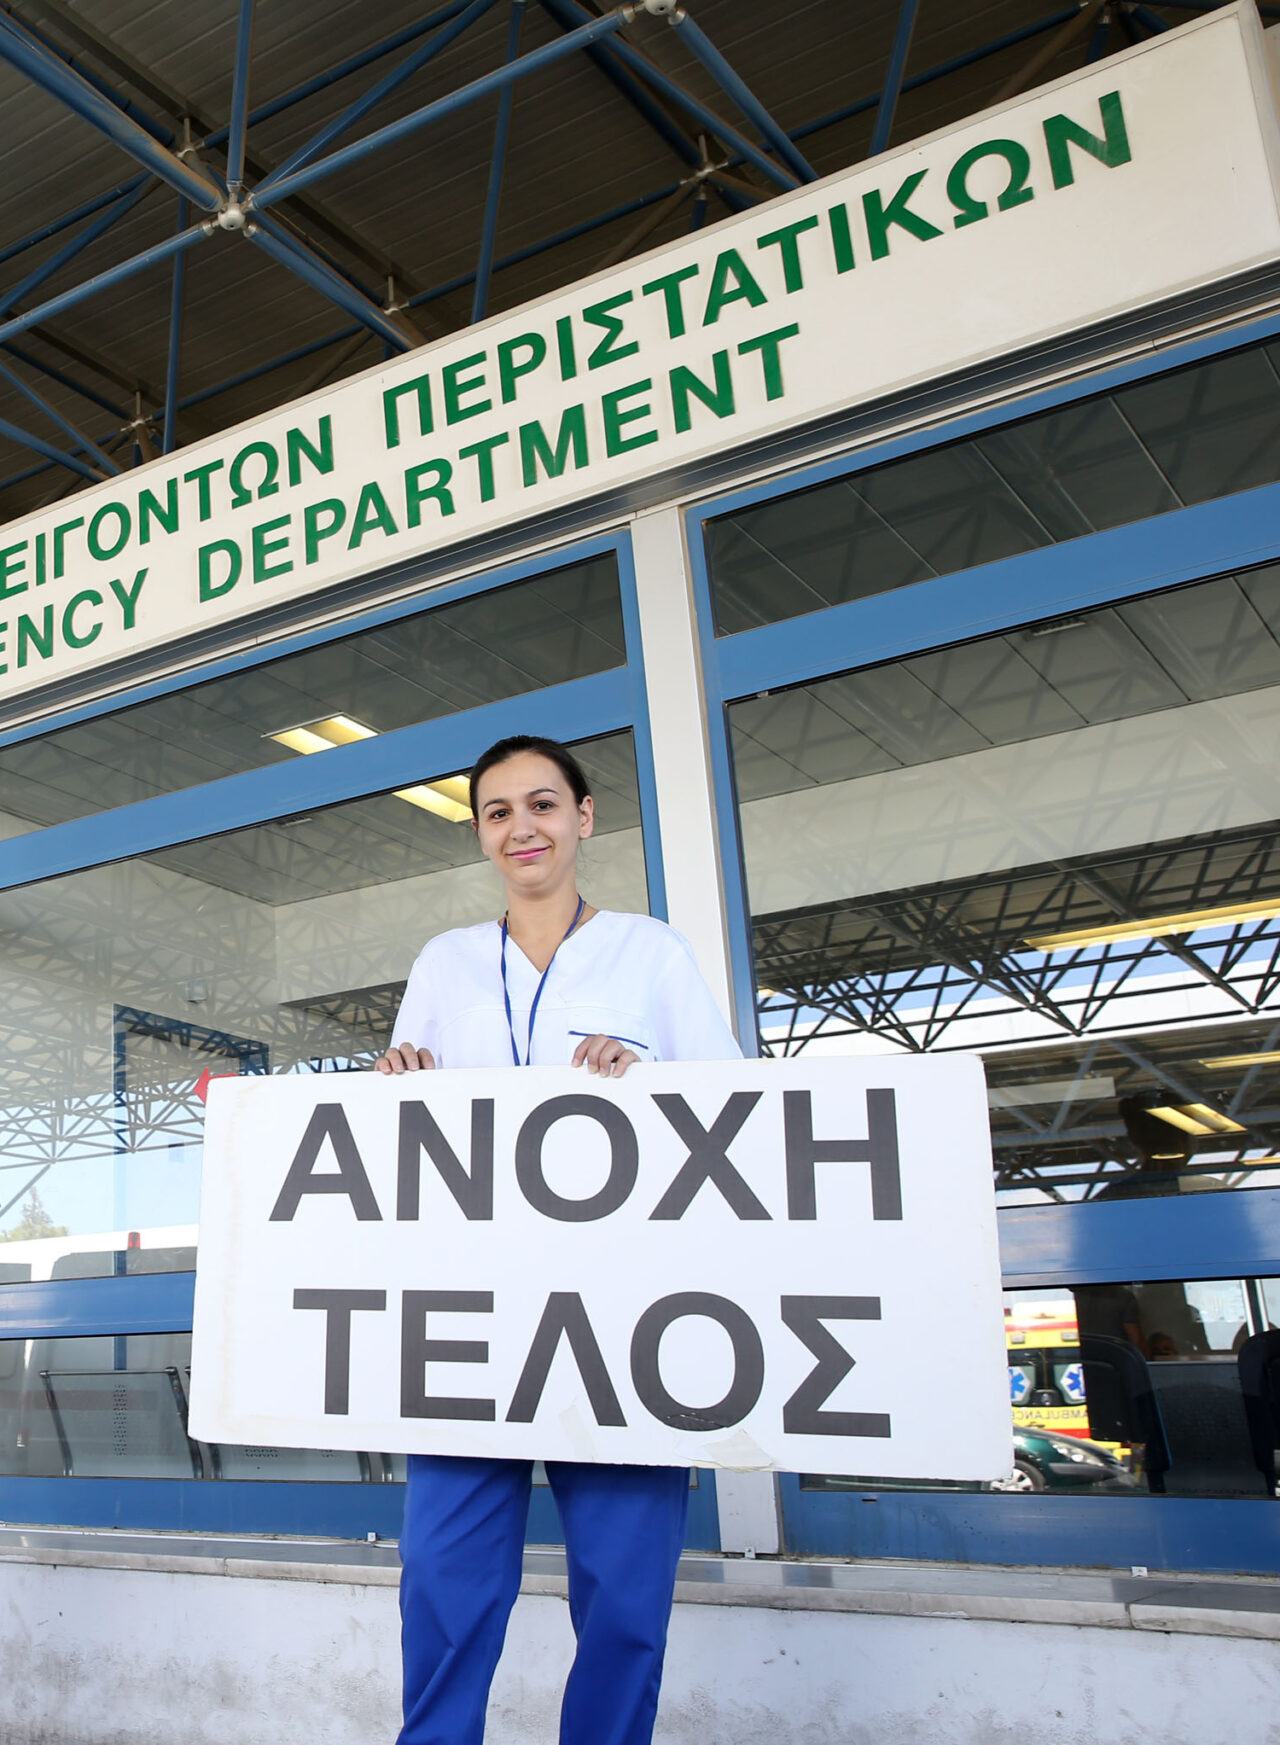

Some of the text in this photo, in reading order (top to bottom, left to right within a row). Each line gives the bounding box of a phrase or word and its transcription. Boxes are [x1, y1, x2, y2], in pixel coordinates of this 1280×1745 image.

[382, 90, 1132, 450] ΠΕΡΙΣΤΑΤΙΚΩΝ
[198, 322, 801, 603] DEPARTMENT
[269, 1088, 903, 1222] ΑΝΟΧΗ
[293, 1289, 892, 1439] ΤΕΛΟΣ
